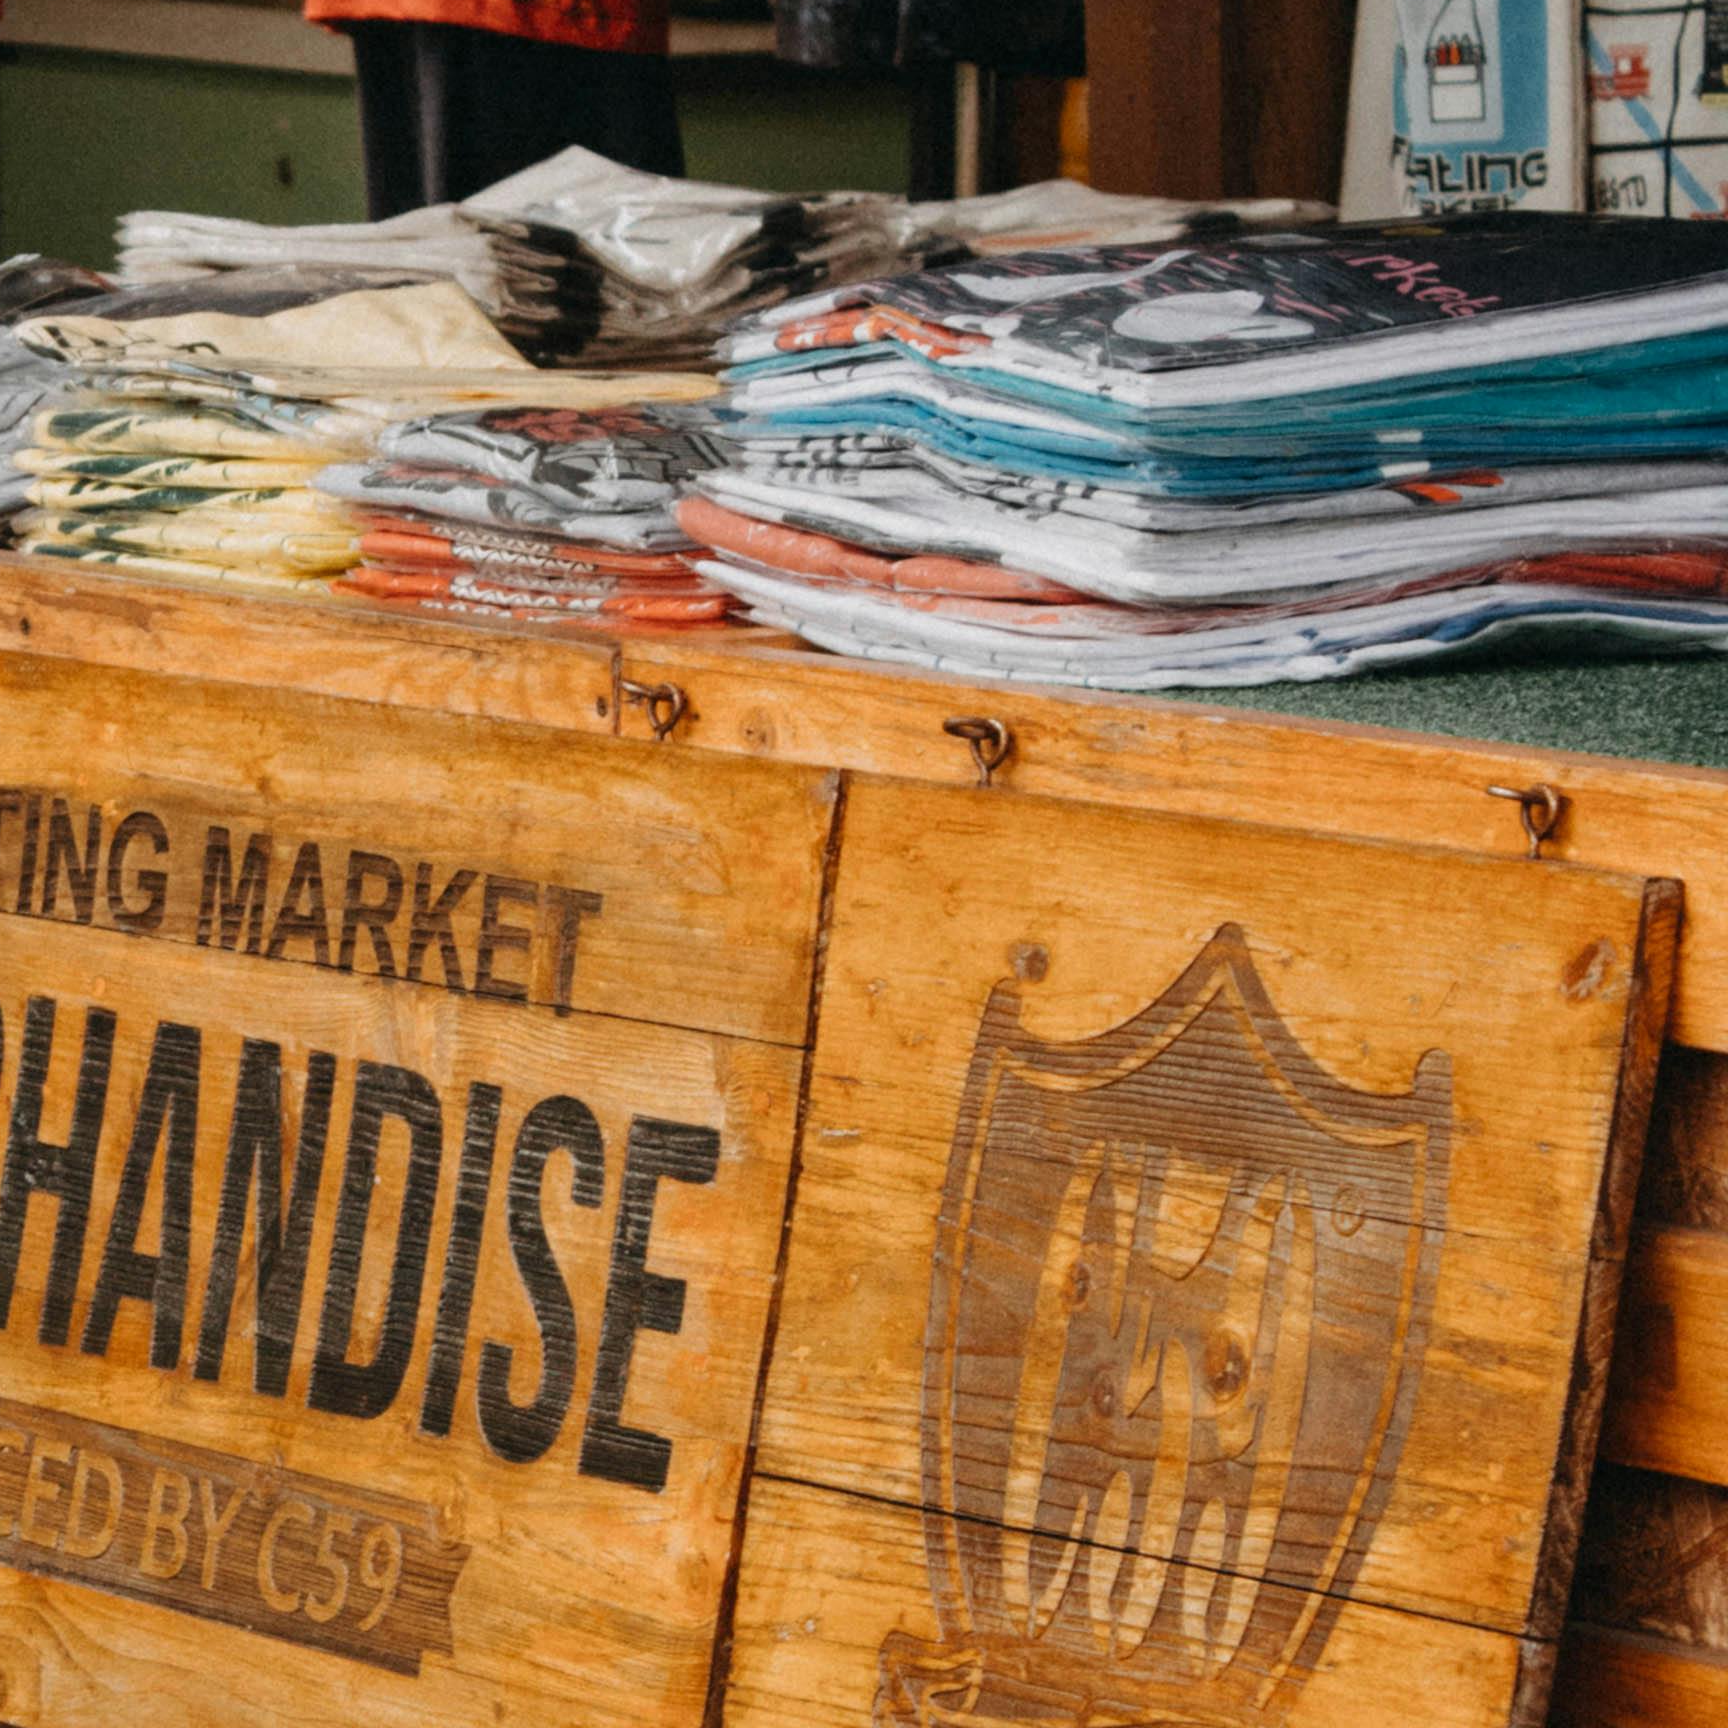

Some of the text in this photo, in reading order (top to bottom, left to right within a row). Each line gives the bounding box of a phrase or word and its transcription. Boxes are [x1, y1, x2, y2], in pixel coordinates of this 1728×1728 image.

[195, 825, 605, 1018] MARKET
[138, 1470, 247, 1592] BY
[256, 1498, 404, 1634] C59
